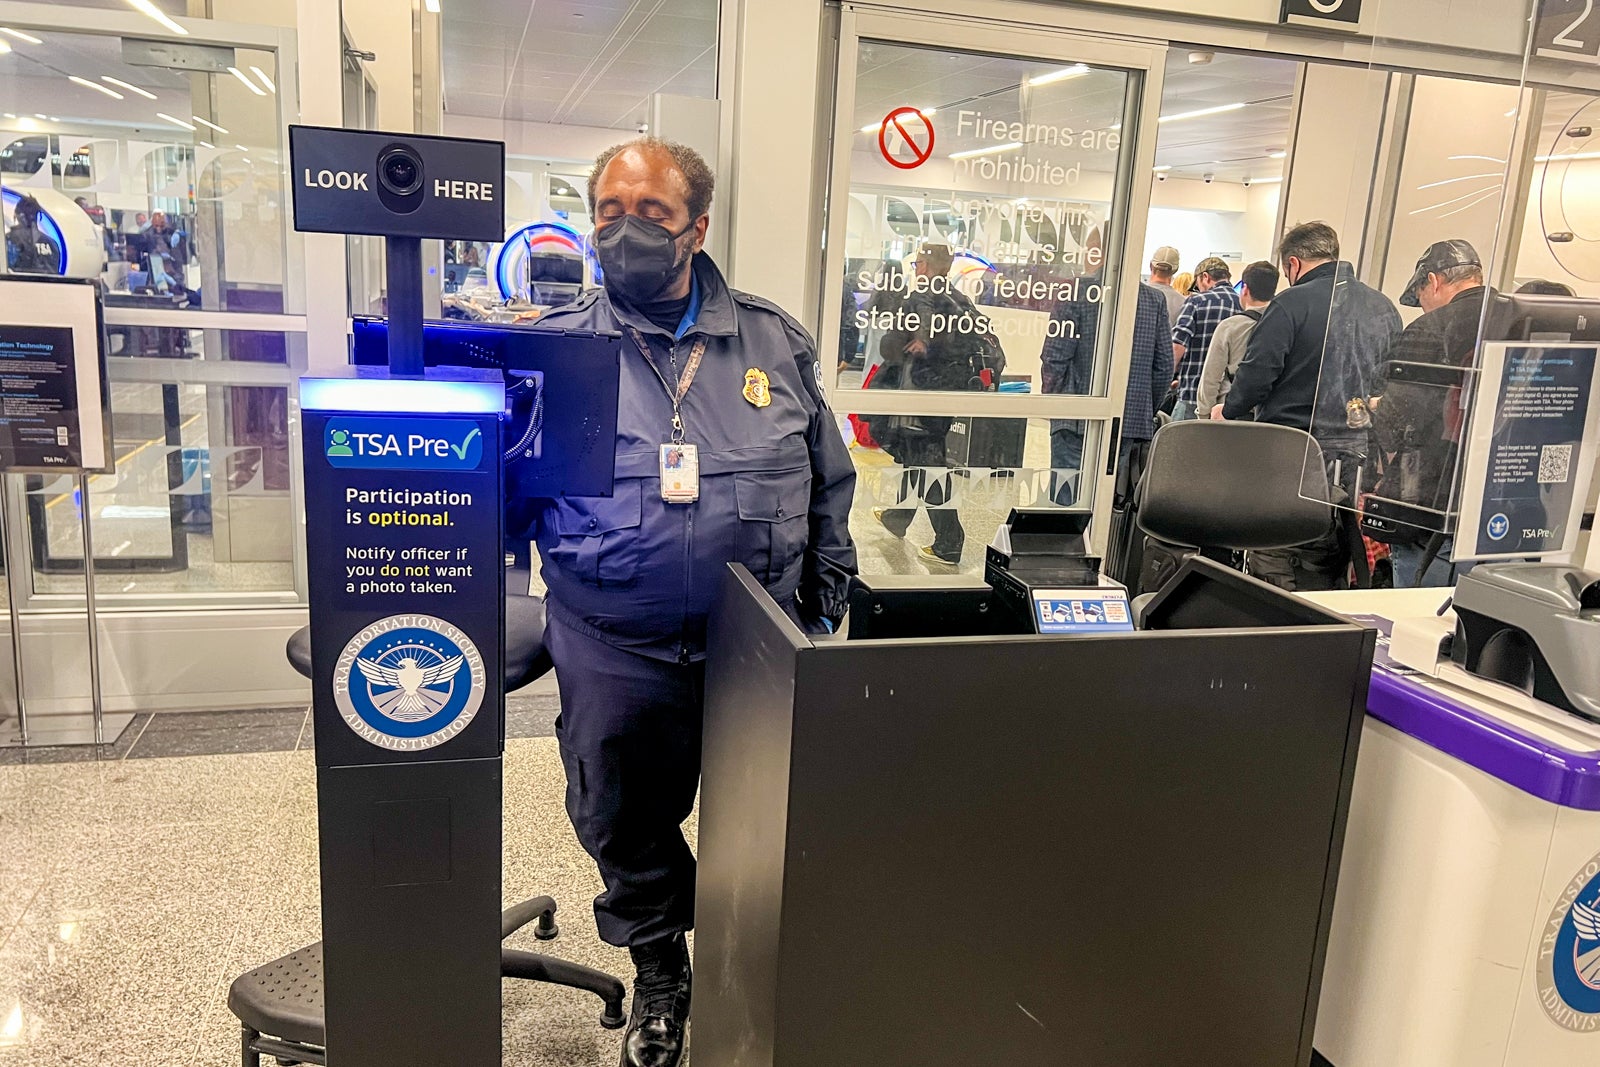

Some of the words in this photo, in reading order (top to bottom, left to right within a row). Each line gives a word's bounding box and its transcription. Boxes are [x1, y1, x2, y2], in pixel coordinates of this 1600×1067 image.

[1552, 0, 1592, 48] 2
[956, 110, 1073, 146] Firearms
[1080, 128, 1120, 150] are
[304, 168, 368, 191] LOOK
[434, 179, 493, 201] HERE
[952, 156, 1080, 186] prohibited
[950, 192, 1044, 225] beyond
[36, 242, 52, 255] TSA
[1062, 246, 1102, 266] are
[857, 264, 953, 299] subject
[961, 274, 984, 296] to
[993, 273, 1078, 302] federal
[1086, 284, 1111, 304] or
[854, 306, 920, 332] state
[930, 311, 1081, 339] prosecution.
[352, 433, 402, 456] TSA
[408, 434, 449, 457] Pre
[346, 488, 472, 506] Participation
[346, 510, 362, 524] is
[368, 510, 454, 527] optional.
[1522, 529, 1536, 538] TSA
[1537, 528, 1550, 538] Pre
[346, 547, 395, 562] Notify
[401, 548, 451, 560] officer
[456, 548, 468, 560] if
[346, 566, 374, 578] you
[380, 564, 400, 576] do
[405, 566, 430, 576] not
[436, 565, 472, 577] want
[346, 583, 355, 593] a
[360, 581, 405, 595] photo
[410, 582, 456, 593] taken.
[336, 616, 443, 694] TRANSPORTATION
[444, 626, 484, 690] SECURITY
[345, 710, 473, 749] ADMINISTRATION
[1540, 855, 1600, 960] TRANSPO
[1540, 986, 1600, 1030] ADMINIS
